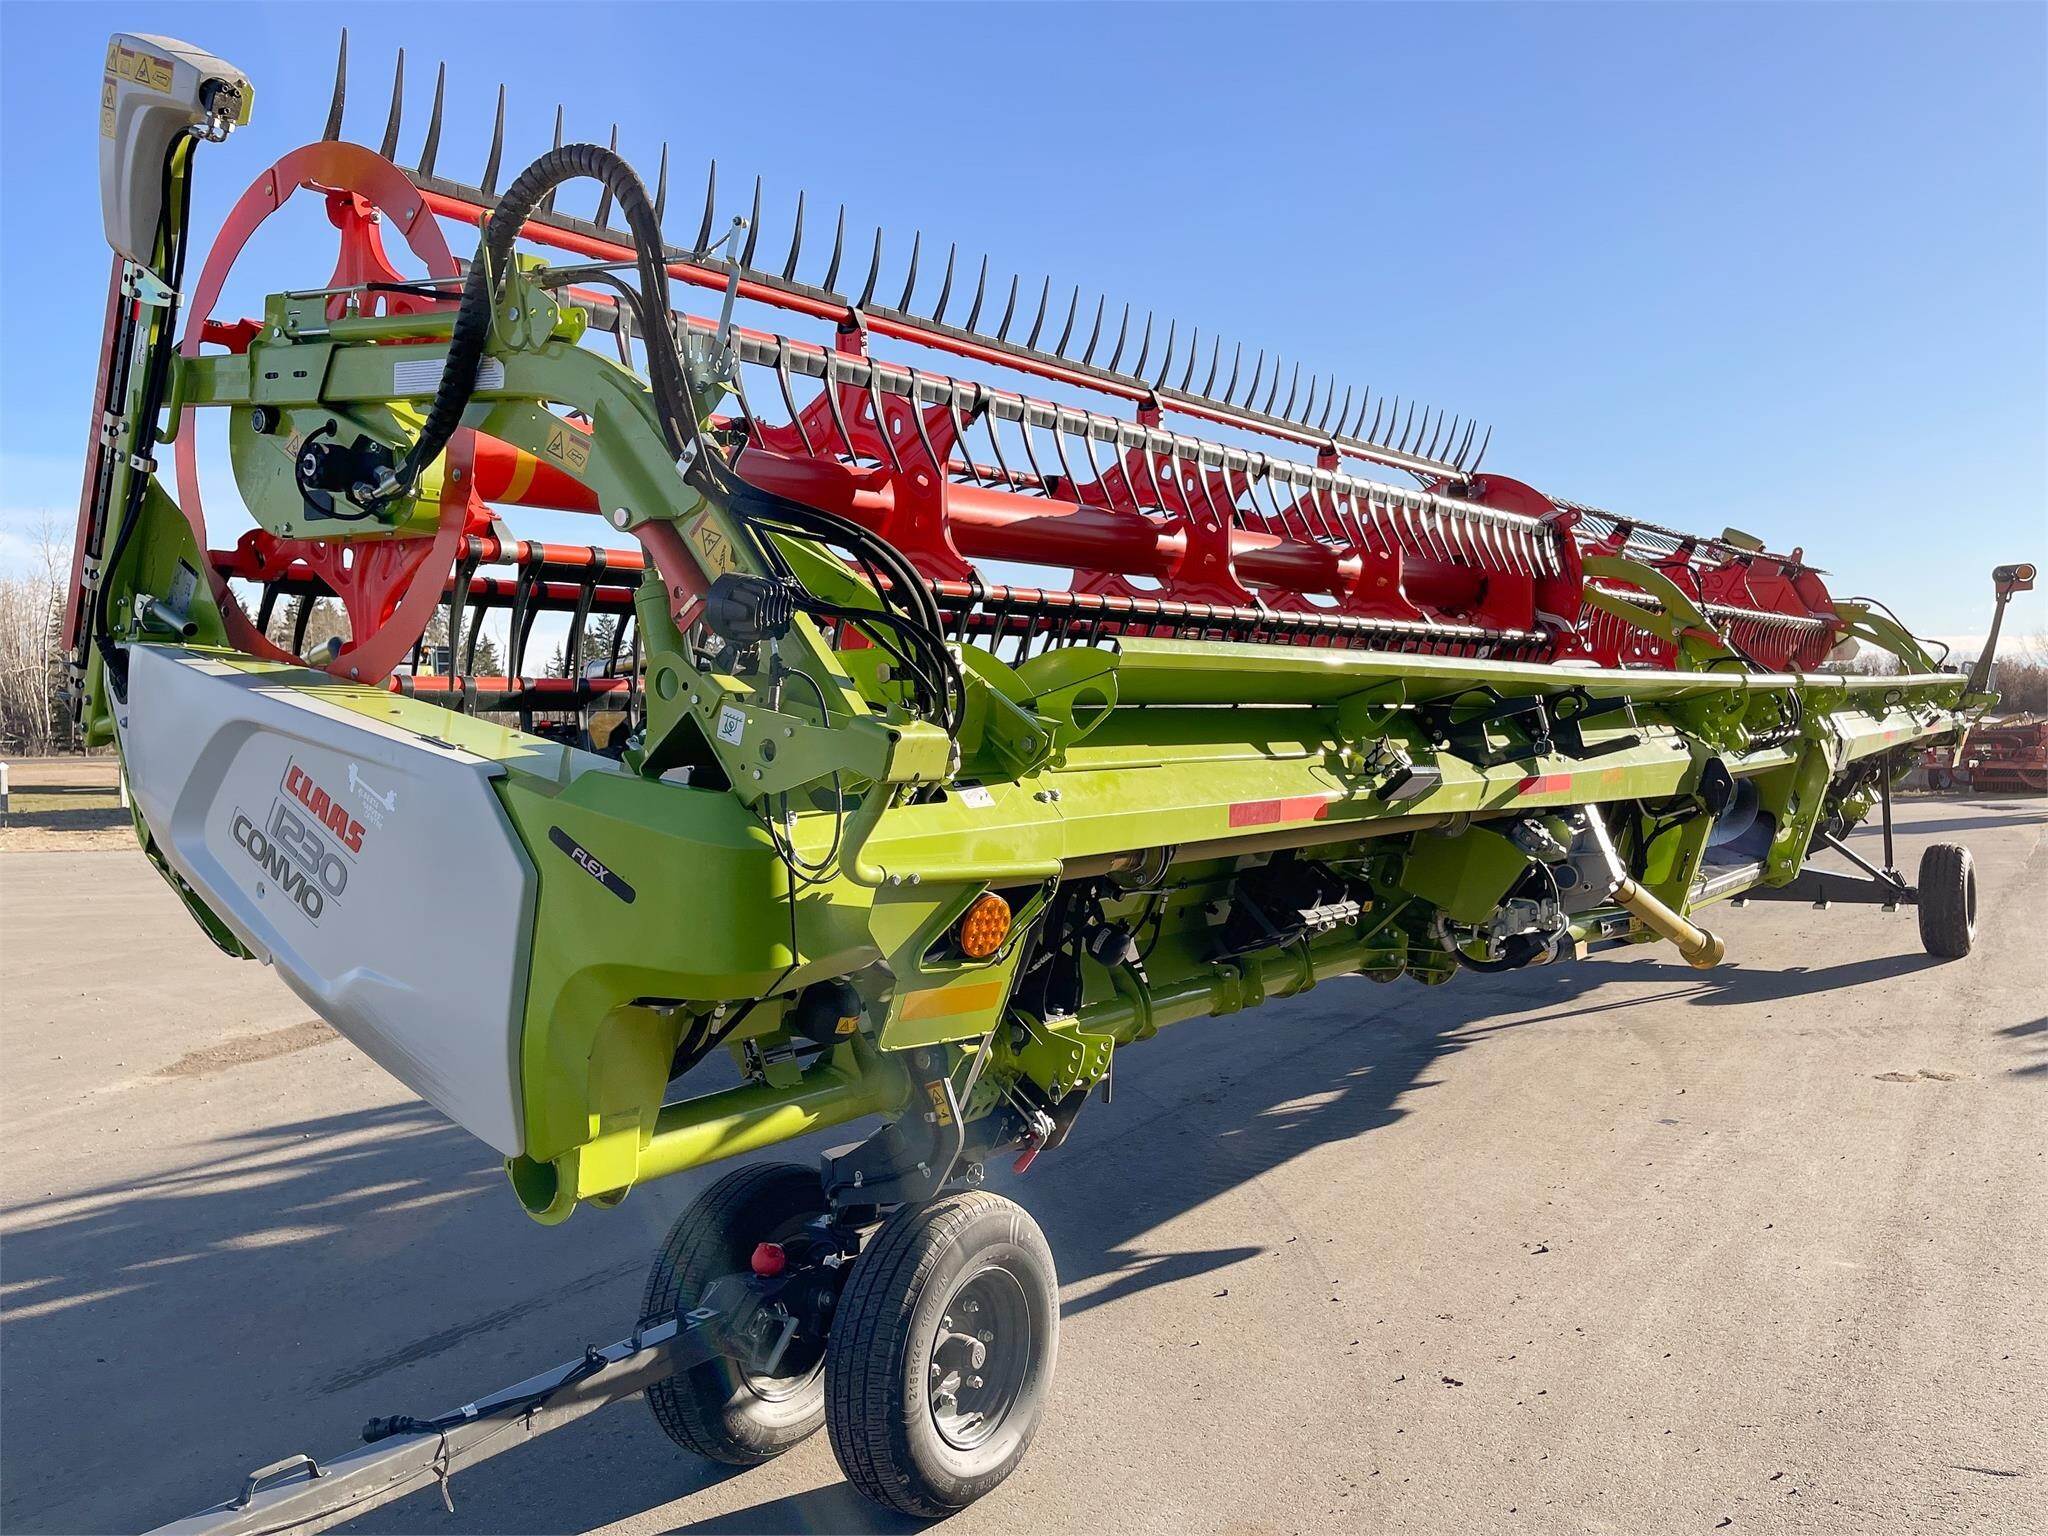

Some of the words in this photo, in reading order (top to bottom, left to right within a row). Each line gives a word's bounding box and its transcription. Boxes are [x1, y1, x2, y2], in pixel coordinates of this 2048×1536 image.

[270, 803, 348, 897] 1230
[286, 765, 366, 854] CLAAS
[233, 815, 324, 919] CONVIO
[571, 847, 609, 882] FLEX
